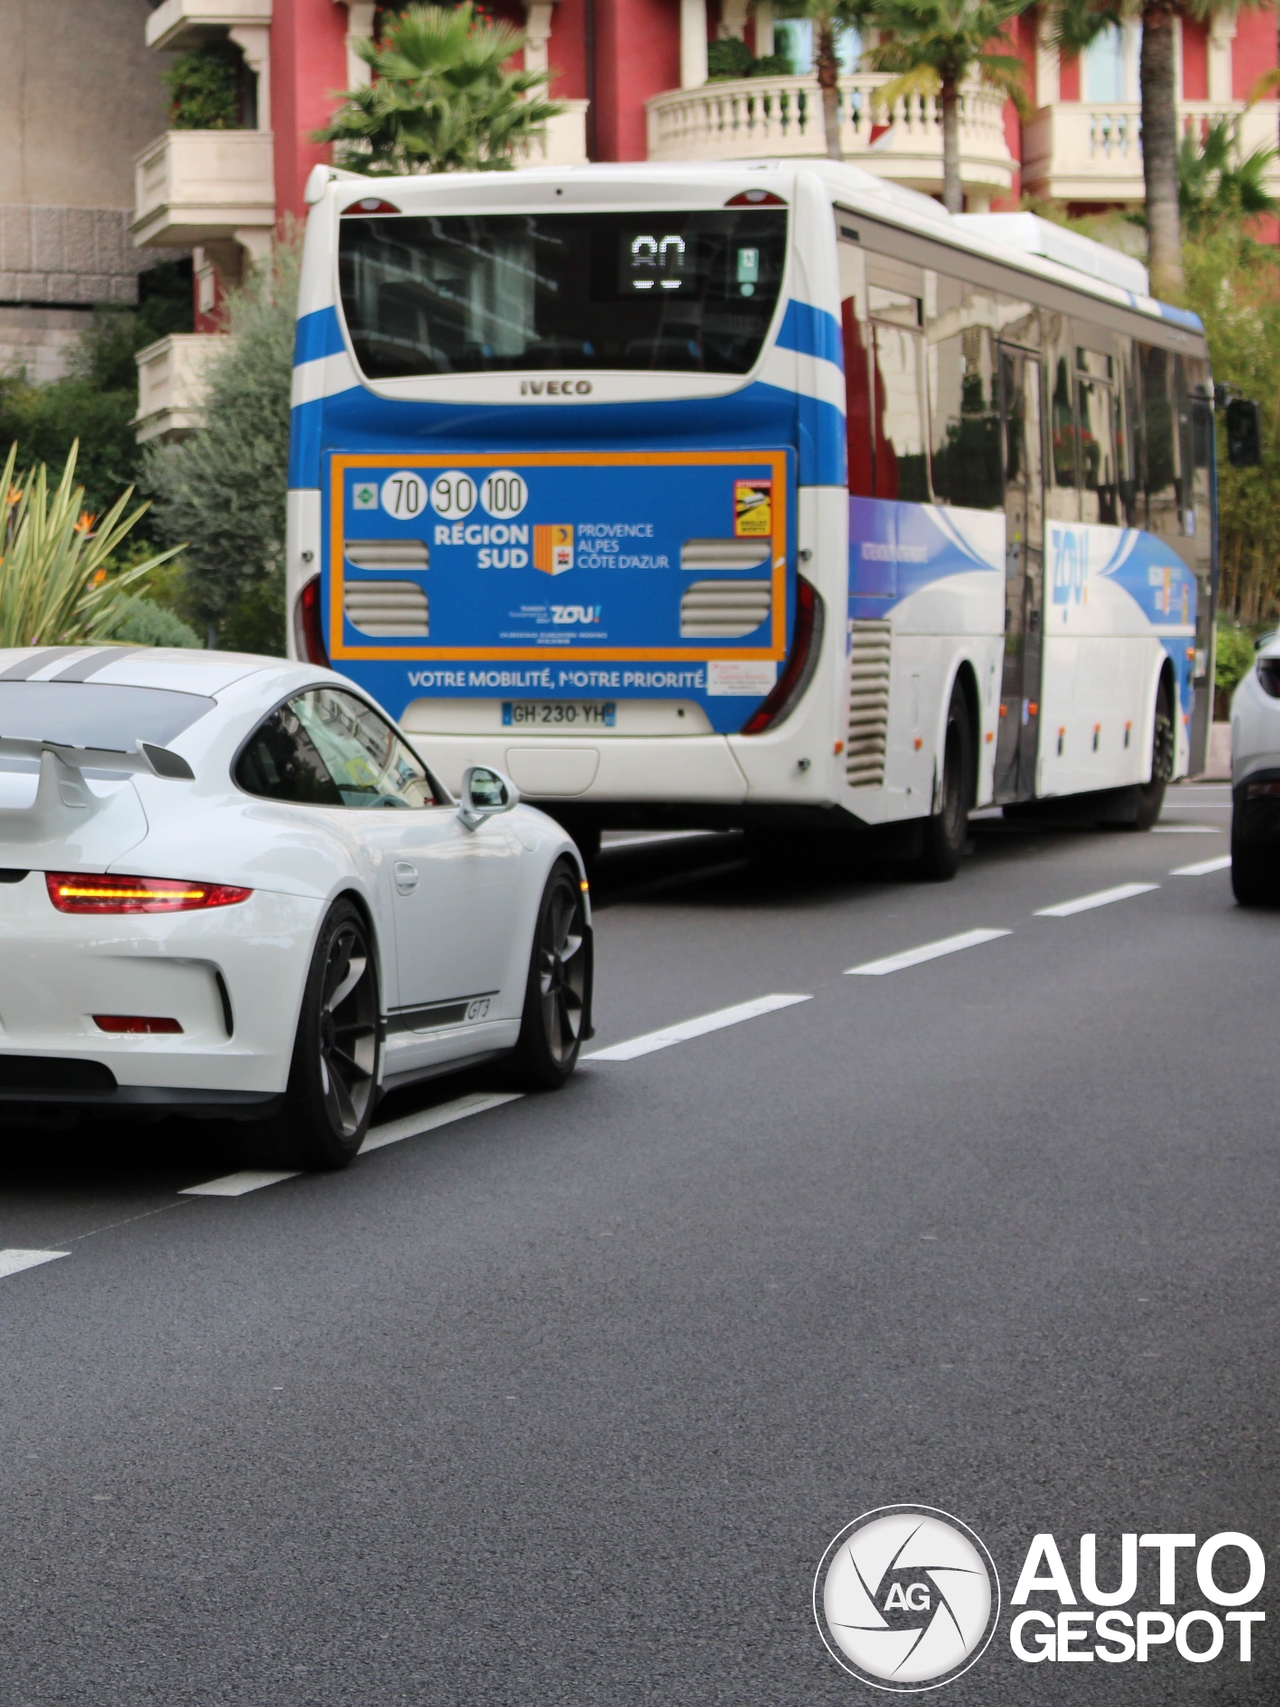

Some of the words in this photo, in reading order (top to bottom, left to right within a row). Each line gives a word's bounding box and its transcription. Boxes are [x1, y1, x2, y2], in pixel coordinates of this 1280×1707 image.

[520, 380, 593, 396] IVECO
[391, 479, 419, 514] 70
[435, 478, 472, 513] 90
[487, 477, 522, 512] 100
[434, 521, 530, 546] RÉGION
[577, 523, 654, 538] PROVENCE
[577, 539, 620, 553] ALPES
[477, 548, 529, 570] SUD
[577, 553, 617, 569] CÔTE
[618, 555, 670, 569] D'AZUR
[408, 671, 466, 687] VOTRE
[469, 668, 555, 690] MOBILITÉ,
[468, 998, 490, 1020] GT3
